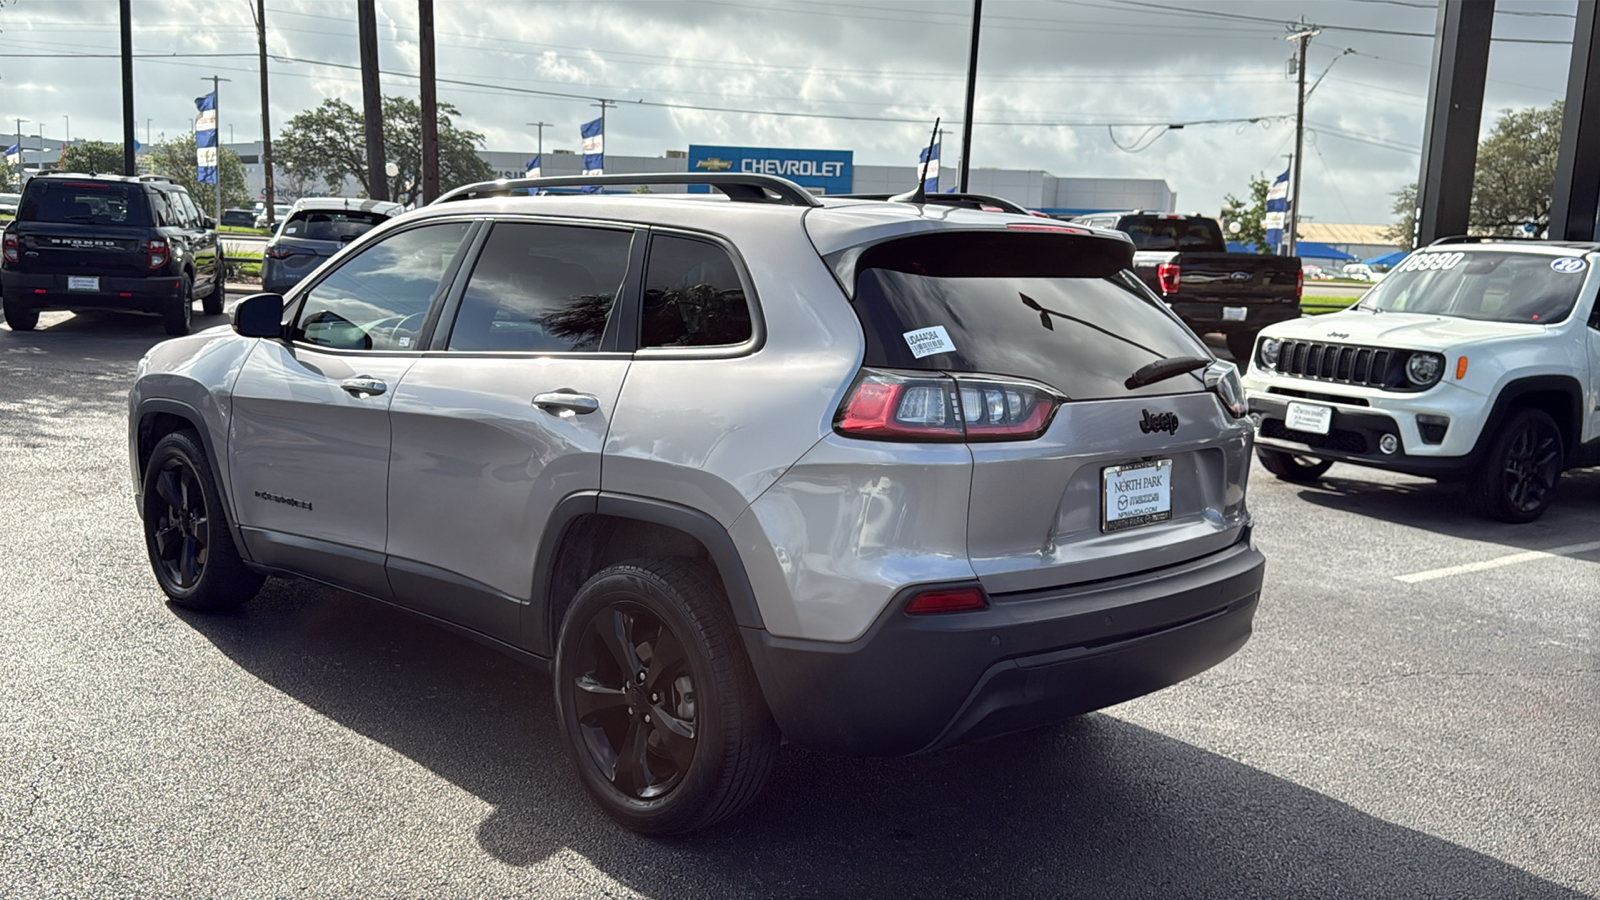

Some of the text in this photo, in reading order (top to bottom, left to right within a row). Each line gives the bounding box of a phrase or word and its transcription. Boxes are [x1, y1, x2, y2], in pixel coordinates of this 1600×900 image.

[741, 158, 845, 177] CHEVROLET
[261, 187, 299, 198] Crtified
[1398, 252, 1465, 272] 18990
[1554, 258, 1582, 272] 20
[1139, 409, 1179, 435] Jeep
[1114, 475, 1163, 493] NORTH PARK
